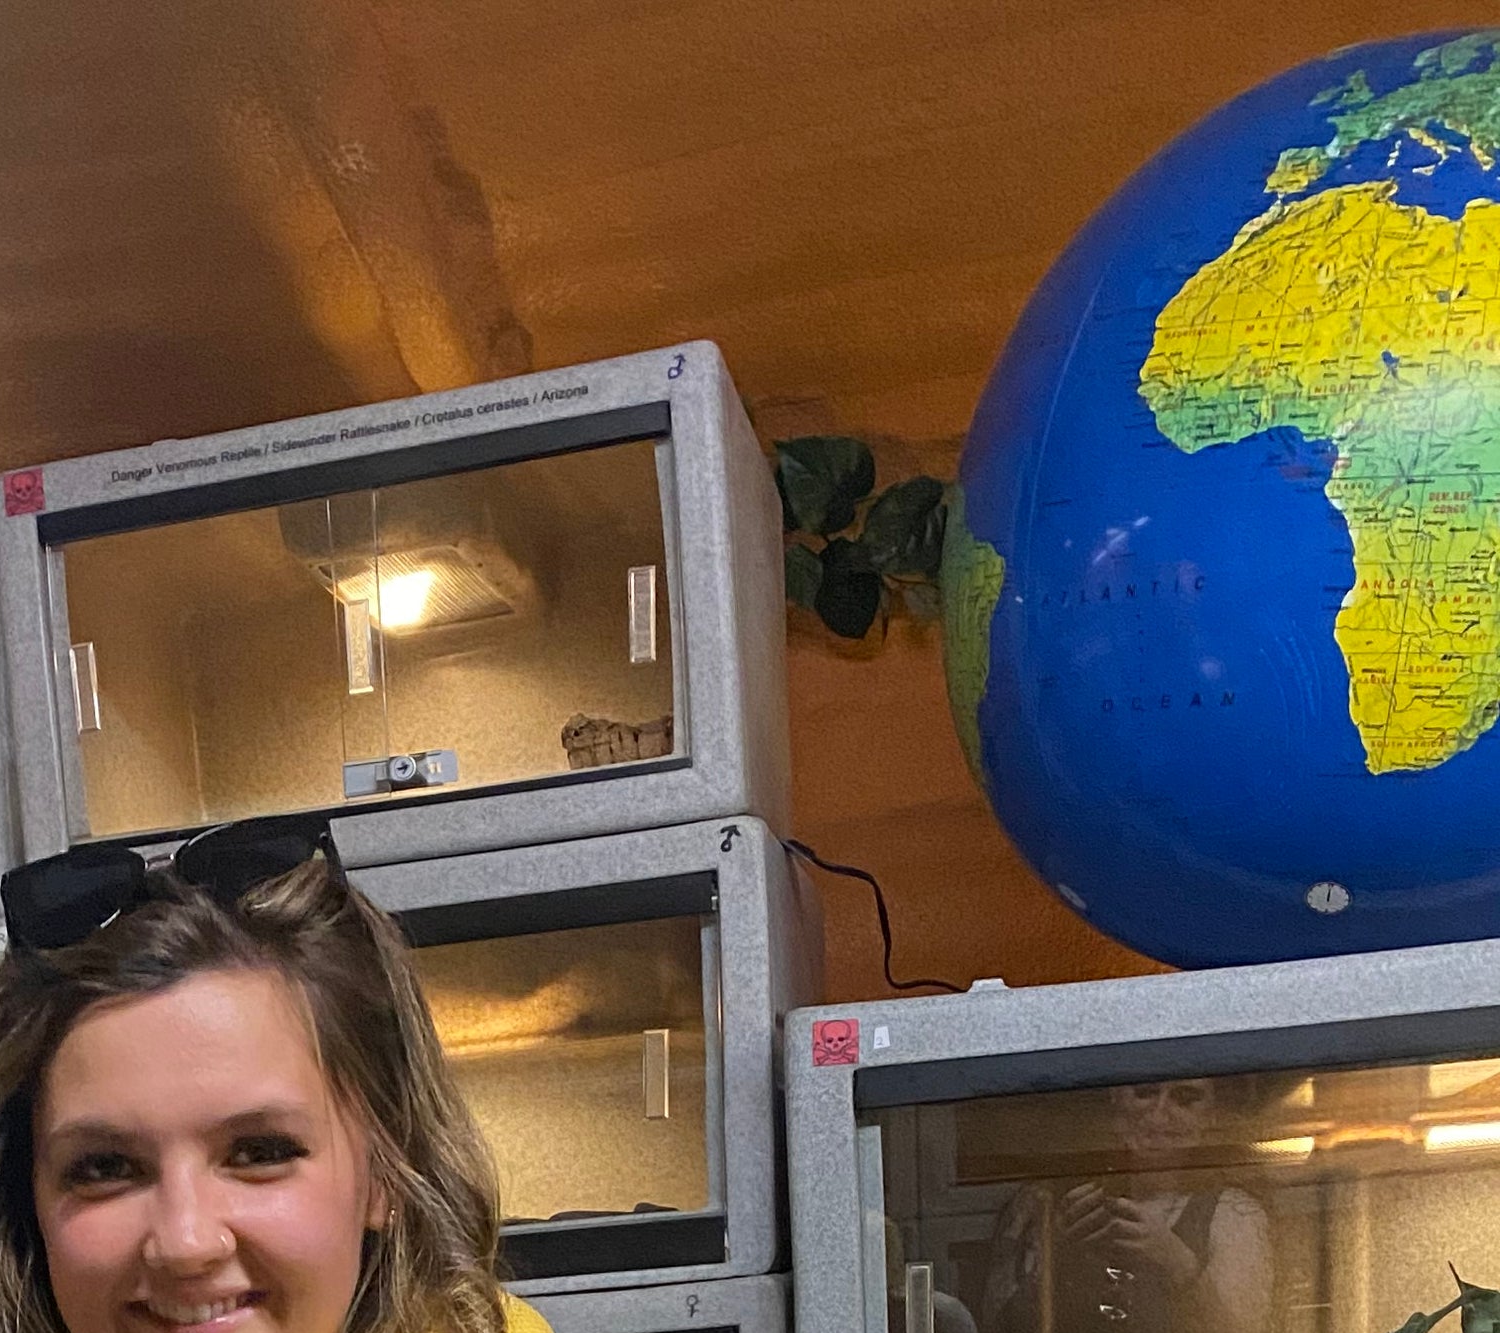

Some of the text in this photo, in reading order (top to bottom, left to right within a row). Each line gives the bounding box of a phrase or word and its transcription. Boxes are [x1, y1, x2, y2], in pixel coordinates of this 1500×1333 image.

[1413, 327, 1464, 339] CHAD
[111, 467, 153, 483] Danger
[156, 455, 218, 474] Venomous
[221, 447, 262, 462] Reptile
[272, 433, 337, 454] Sidewinder
[340, 419, 411, 441] Rattlesnake
[422, 407, 474, 426] Crotalus
[477, 395, 529, 415] cerastes
[540, 384, 589, 403] Arizona
[1041, 576, 1206, 606] ATLANTIC
[1360, 578, 1434, 590] ANGOLA
[1427, 594, 1492, 604] AMBIA
[1102, 691, 1236, 713] OCEAN
